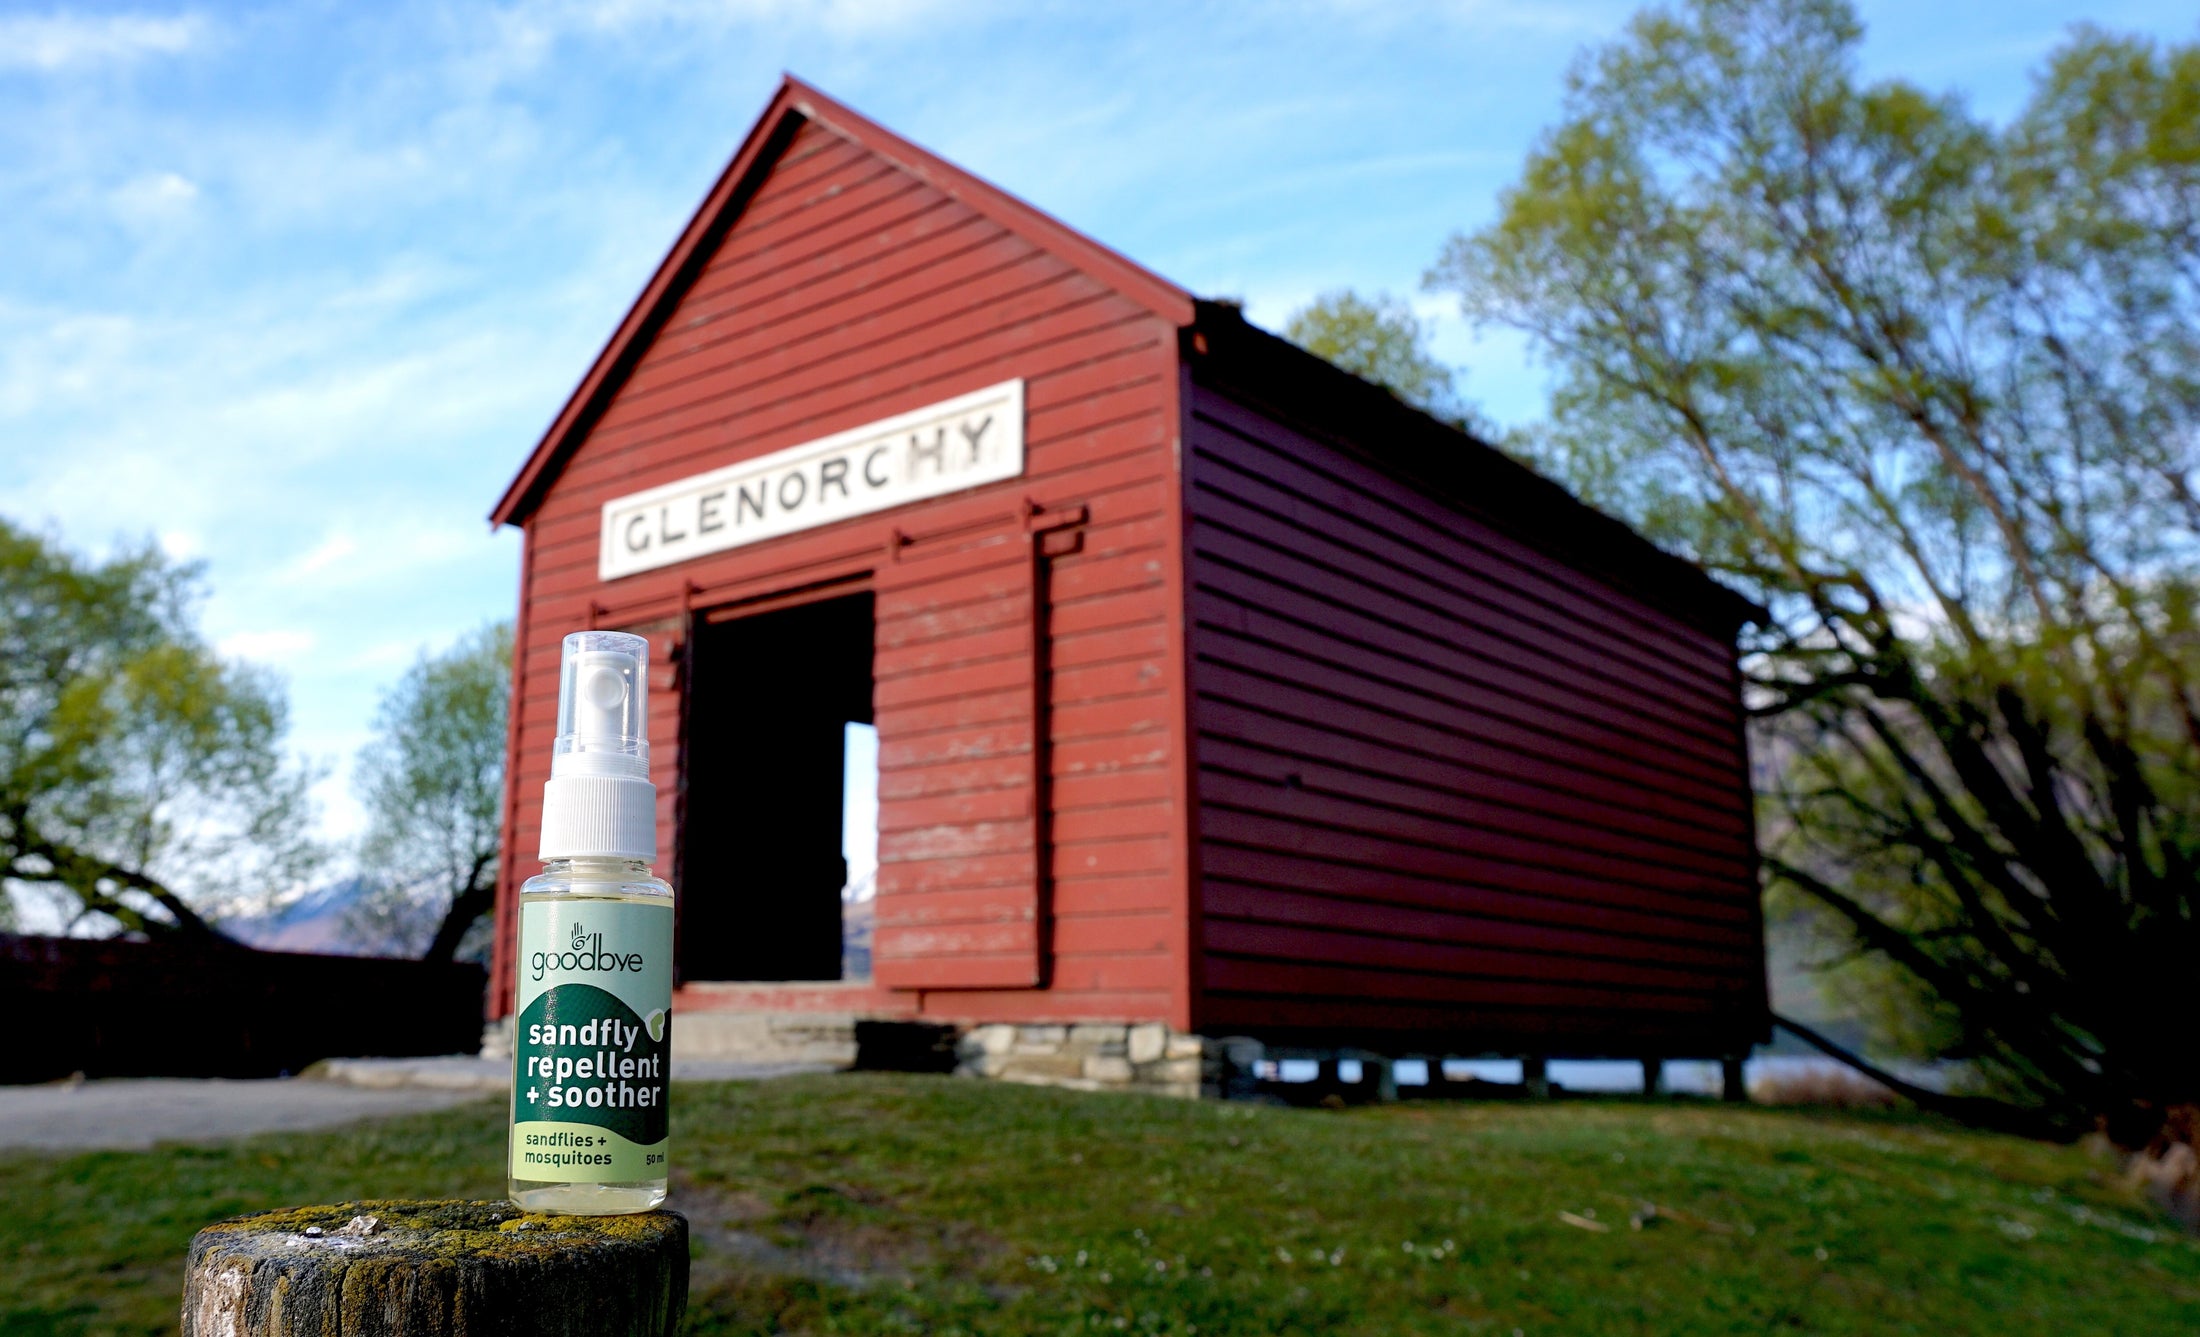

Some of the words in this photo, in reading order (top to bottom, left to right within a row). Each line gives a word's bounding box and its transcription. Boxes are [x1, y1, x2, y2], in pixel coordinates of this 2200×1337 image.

[625, 415, 994, 554] GLENORCHY
[532, 933, 643, 981] goodbye
[528, 1018, 639, 1052] sandfly
[527, 1051, 660, 1084] repellent
[526, 1089, 540, 1105] +
[548, 1081, 661, 1108] soother
[525, 1132, 594, 1147] sandflies
[524, 1150, 613, 1168] mosquitoes
[646, 1154, 656, 1166] 50
